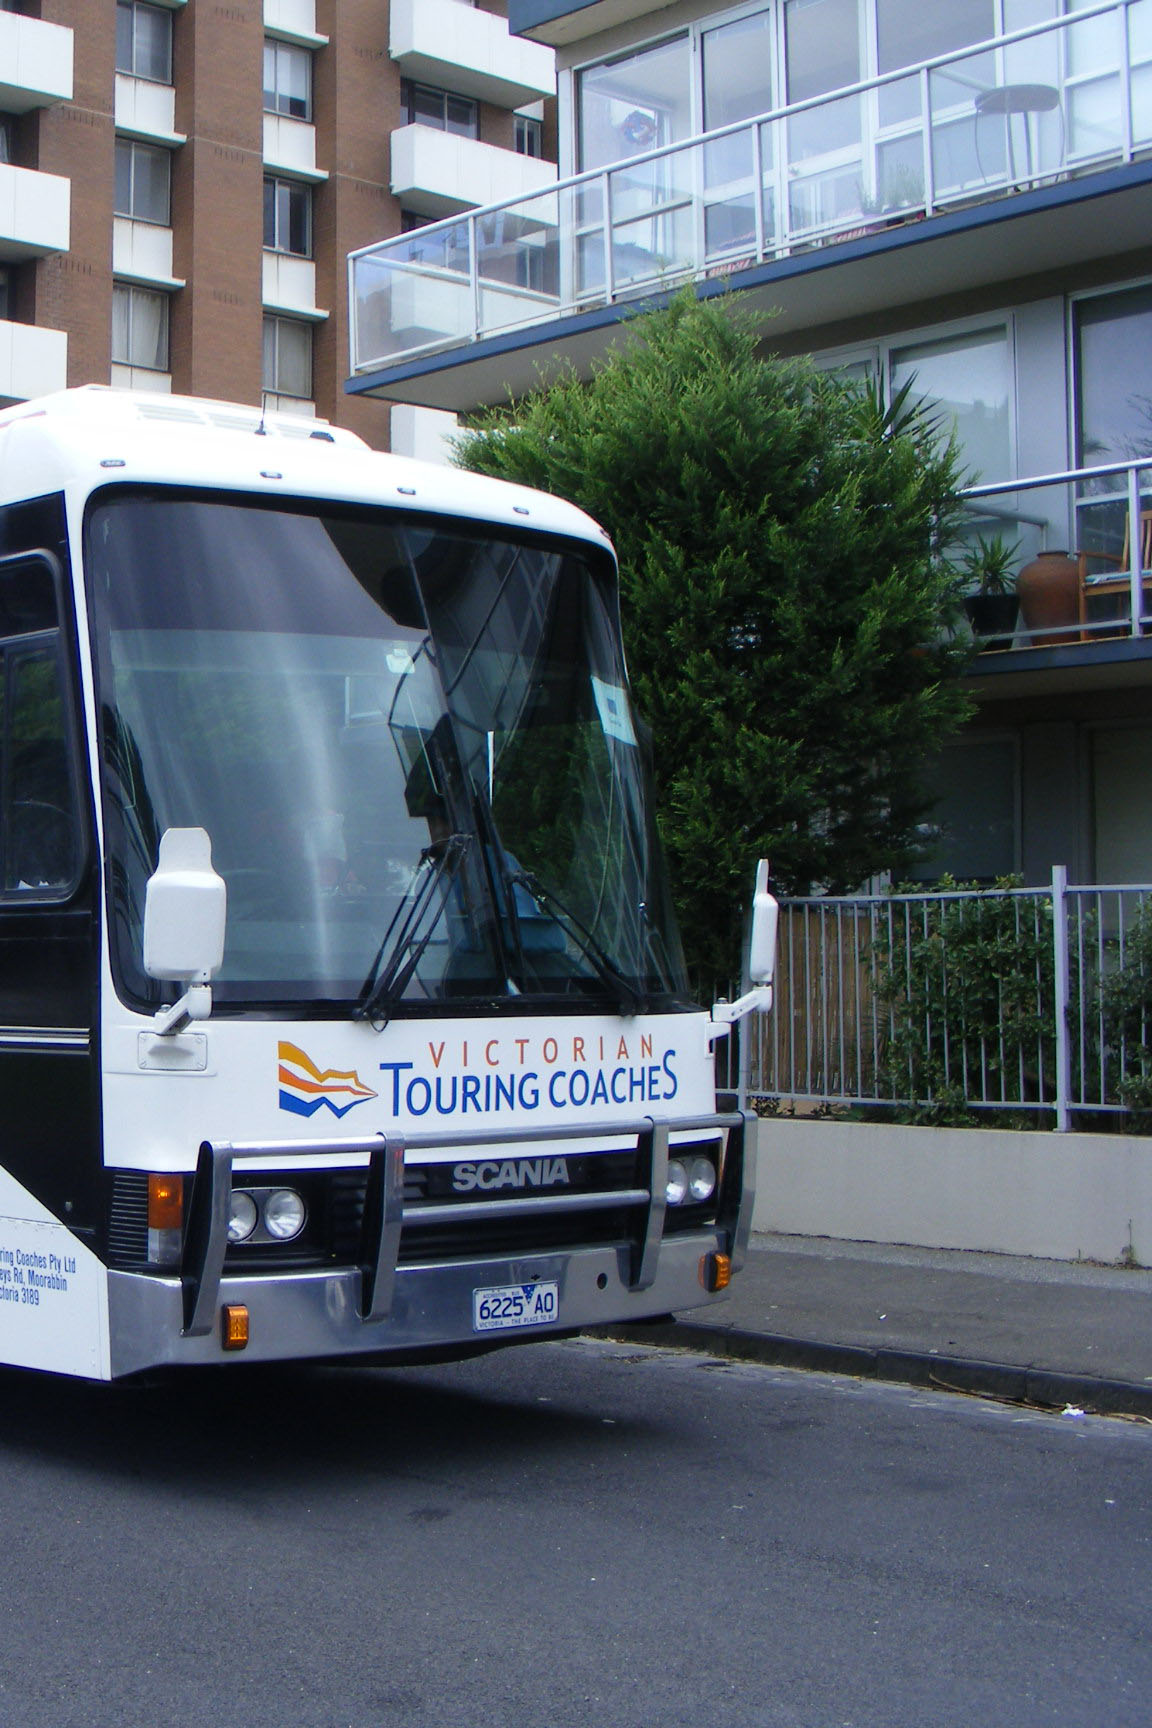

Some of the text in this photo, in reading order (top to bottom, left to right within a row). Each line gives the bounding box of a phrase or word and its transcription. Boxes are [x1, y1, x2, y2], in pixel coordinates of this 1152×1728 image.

[428, 1033, 653, 1069] VICTORIAN
[379, 1049, 678, 1117] TOURING COACHES
[451, 1157, 570, 1193] SCANIA
[16, 1248, 47, 1269] Coaches
[49, 1253, 61, 1274] Pty
[64, 1256, 76, 1274] Ltd
[28, 1269, 68, 1291] Moorabbin
[21, 1287, 40, 1306] 3189
[479, 1295, 524, 1320] 6225
